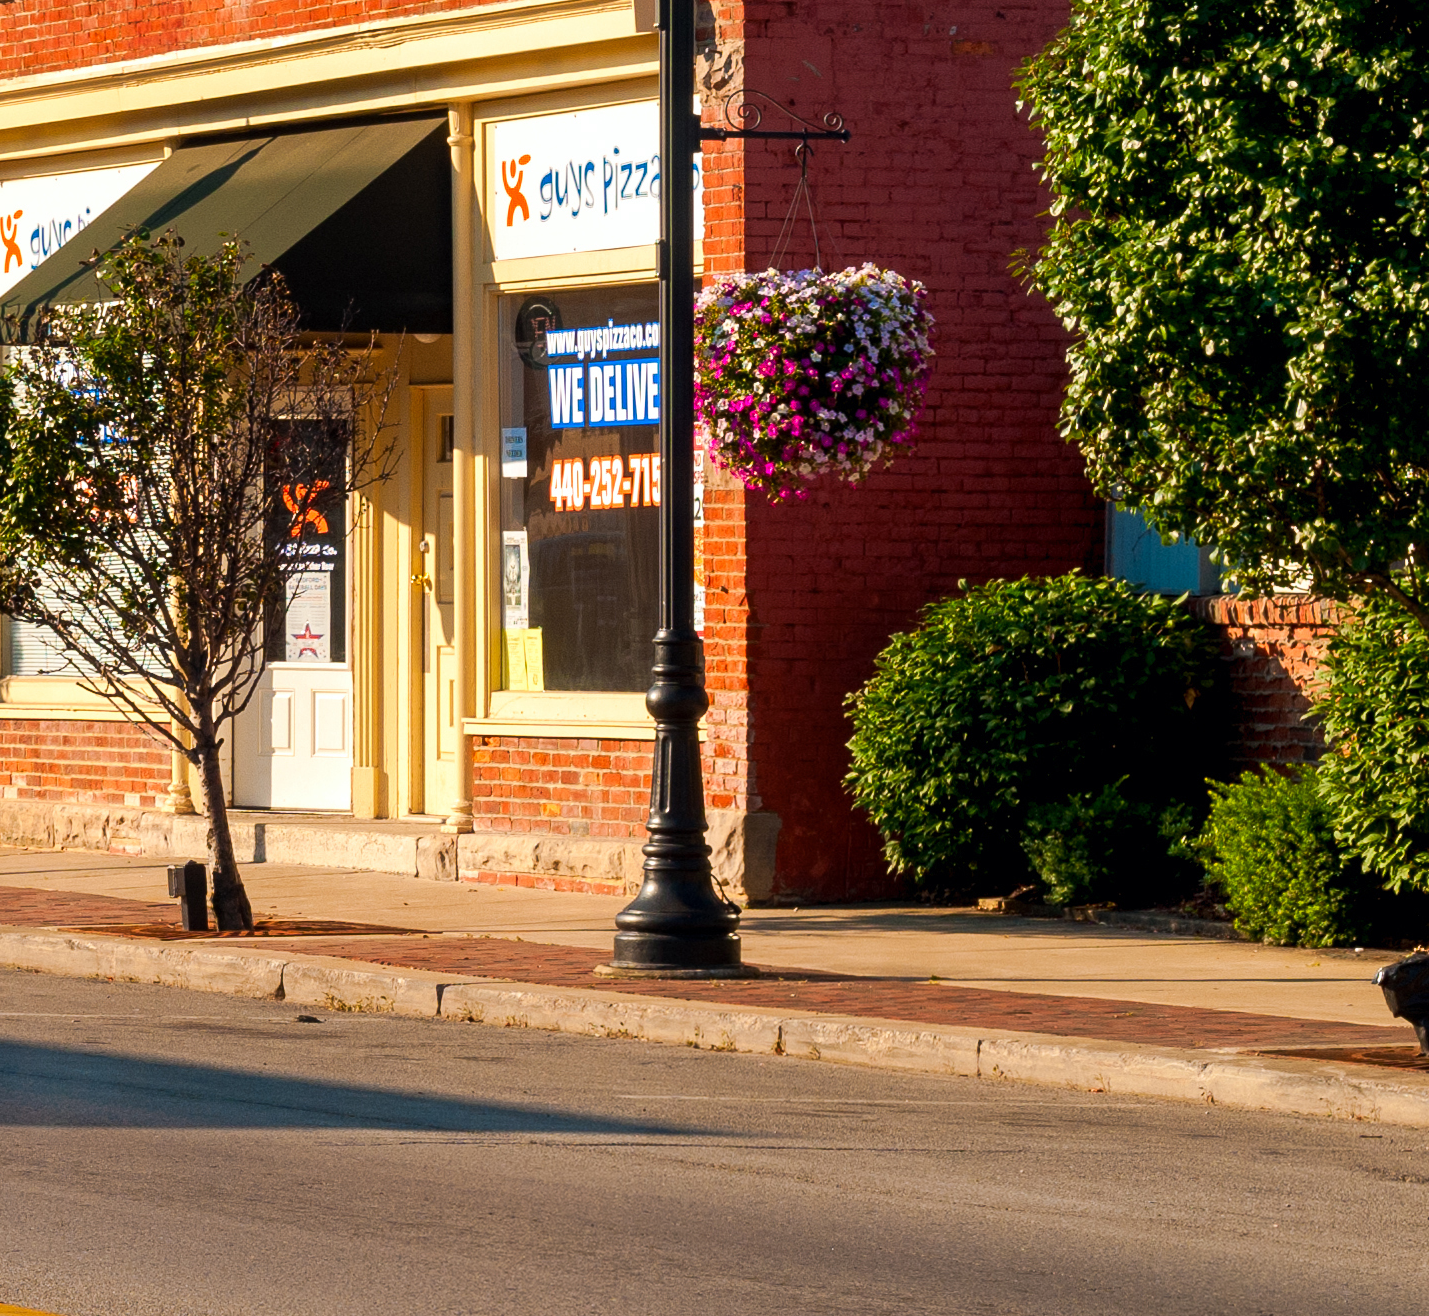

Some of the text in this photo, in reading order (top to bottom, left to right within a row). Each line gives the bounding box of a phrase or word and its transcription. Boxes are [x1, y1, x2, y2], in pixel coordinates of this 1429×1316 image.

[540, 161, 595, 221] guys
[546, 318, 660, 360] www.guyspizzaco.co
[549, 363, 659, 424] WE DELIVE
[550, 453, 661, 512] 440-252-715
